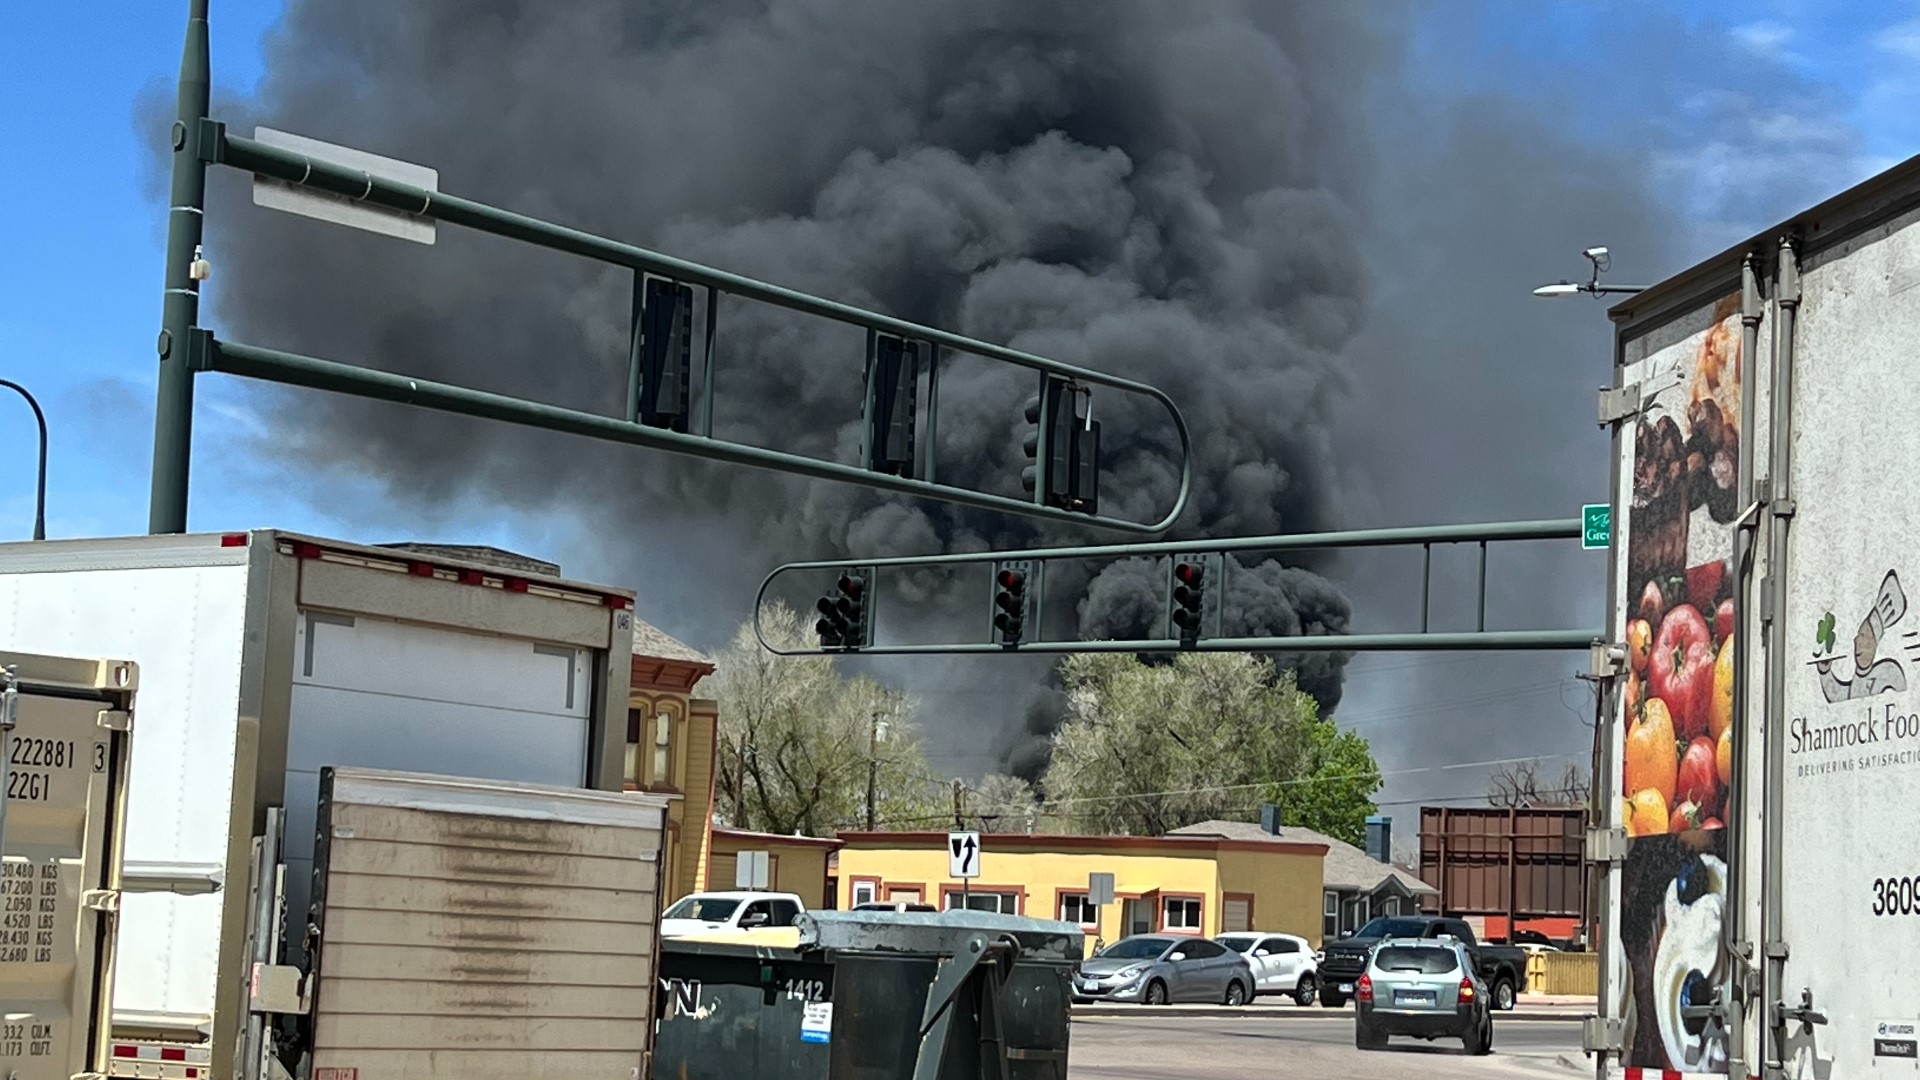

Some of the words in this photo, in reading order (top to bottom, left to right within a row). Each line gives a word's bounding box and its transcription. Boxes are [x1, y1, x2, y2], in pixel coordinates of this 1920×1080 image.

[1790, 706, 1879, 754] Shamrock
[1884, 703, 1920, 741] Foo
[10, 736, 74, 769] 222881
[94, 744, 105, 771] 3
[1797, 760, 1855, 778] DELIVERING
[7, 770, 50, 801] 22G1
[41, 864, 58, 879] KGS
[40, 881, 57, 896] LBS
[39, 898, 56, 912] KGS
[37, 914, 54, 929] LBS
[36, 930, 53, 946] KGS
[34, 947, 51, 962] LBS
[785, 978, 824, 1001] 1412
